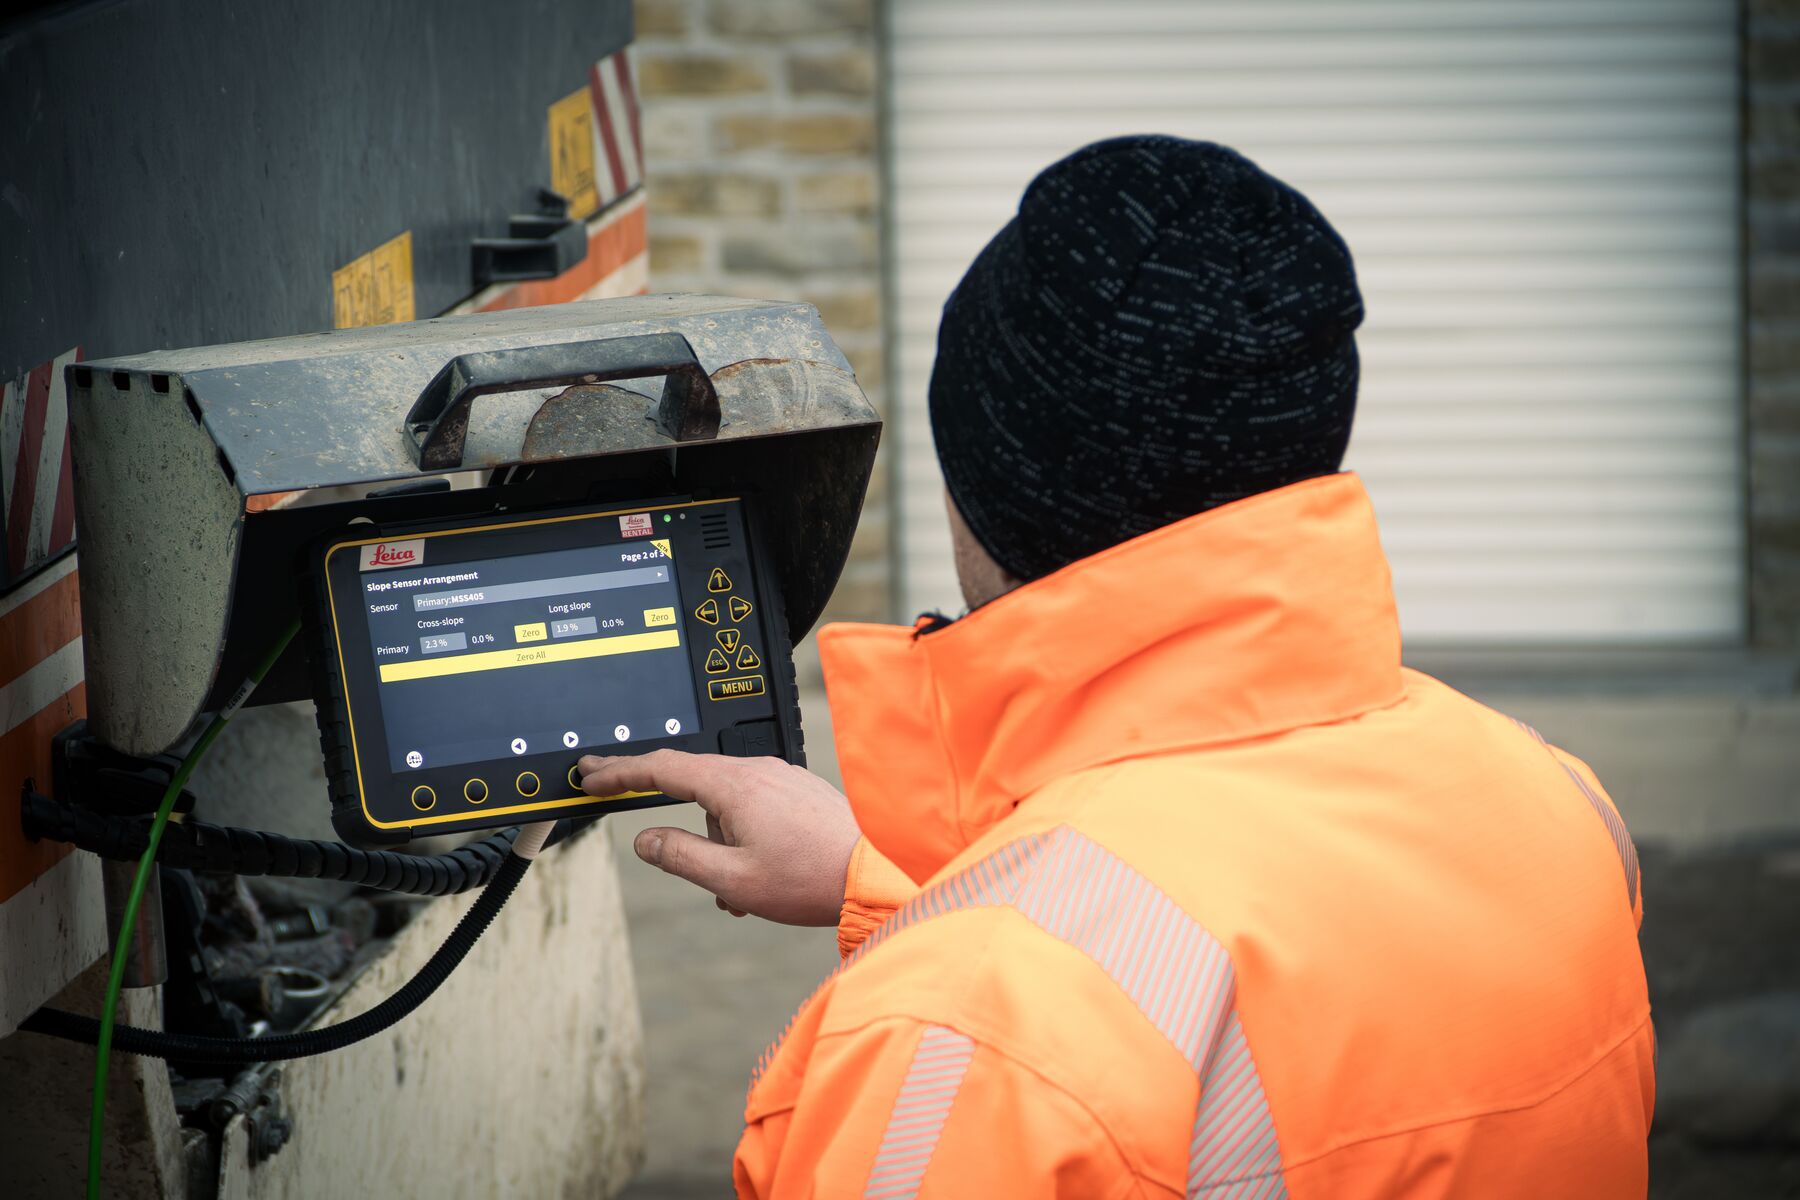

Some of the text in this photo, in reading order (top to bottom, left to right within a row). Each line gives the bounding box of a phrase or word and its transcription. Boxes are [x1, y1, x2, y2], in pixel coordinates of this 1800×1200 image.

[622, 528, 652, 537] RENTAL
[657, 542, 668, 553] BETA
[369, 544, 416, 566] Leica
[621, 553, 642, 562] Page
[649, 549, 658, 558] of
[367, 571, 479, 592] Slope Sensor Arrangement
[417, 592, 484, 608] Primary:MSS405
[370, 603, 398, 613] Sensor
[549, 601, 591, 614] Long slope
[417, 617, 464, 629] Cross-slope
[602, 618, 625, 628] 0.0 %
[651, 613, 669, 622] Zero
[522, 629, 540, 638] Zero
[556, 623, 579, 633] 1.9 %
[425, 638, 448, 649] 2.3 %
[471, 633, 494, 644] 0.0 %
[377, 645, 409, 655] Primary
[516, 650, 546, 662] Zero All
[711, 659, 723, 667] ESC
[722, 680, 753, 694] MENU
